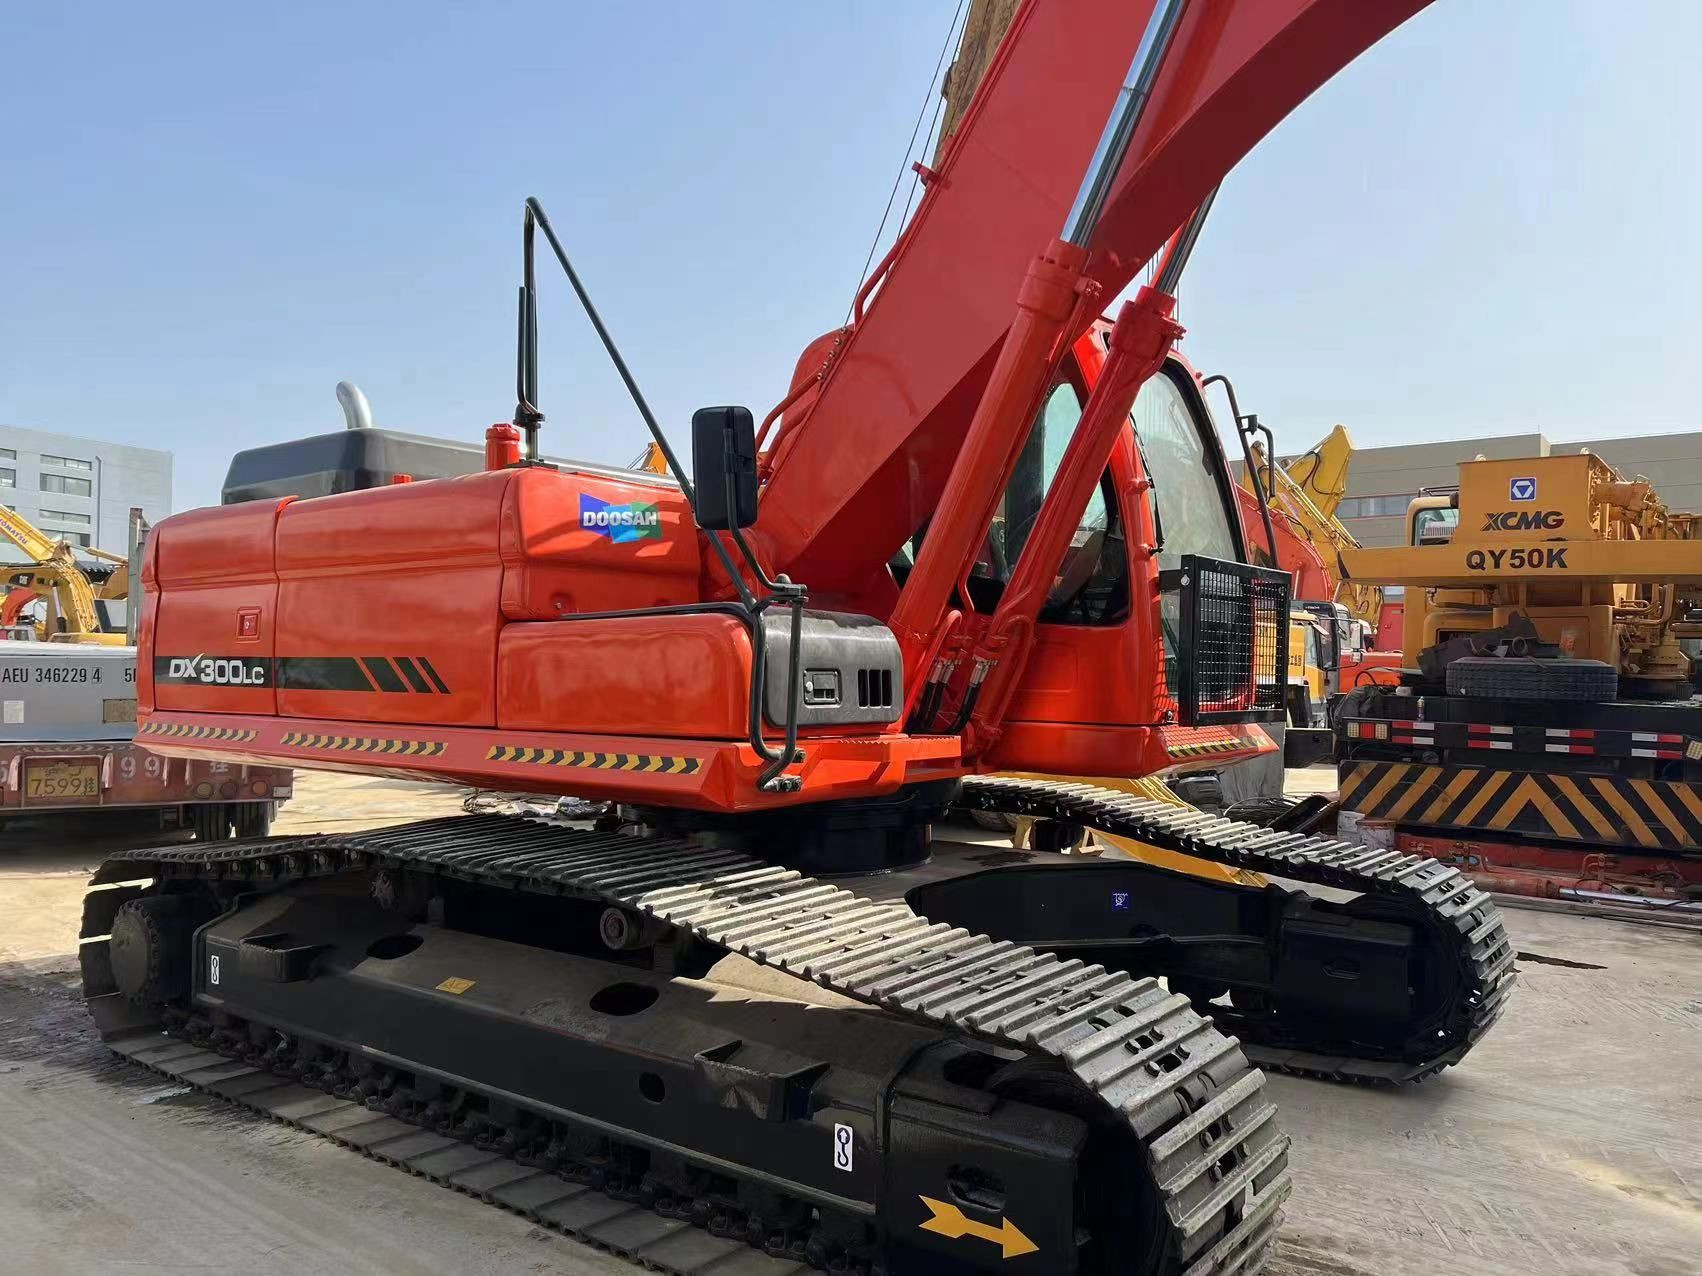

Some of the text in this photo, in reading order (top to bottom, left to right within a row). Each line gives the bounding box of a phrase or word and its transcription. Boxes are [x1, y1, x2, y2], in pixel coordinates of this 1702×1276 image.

[583, 511, 657, 526] DOOSAN
[1480, 511, 1565, 531] XCMG
[1466, 547, 1569, 571] QY50K
[35, 667, 87, 683] 346229
[92, 668, 101, 683] 4
